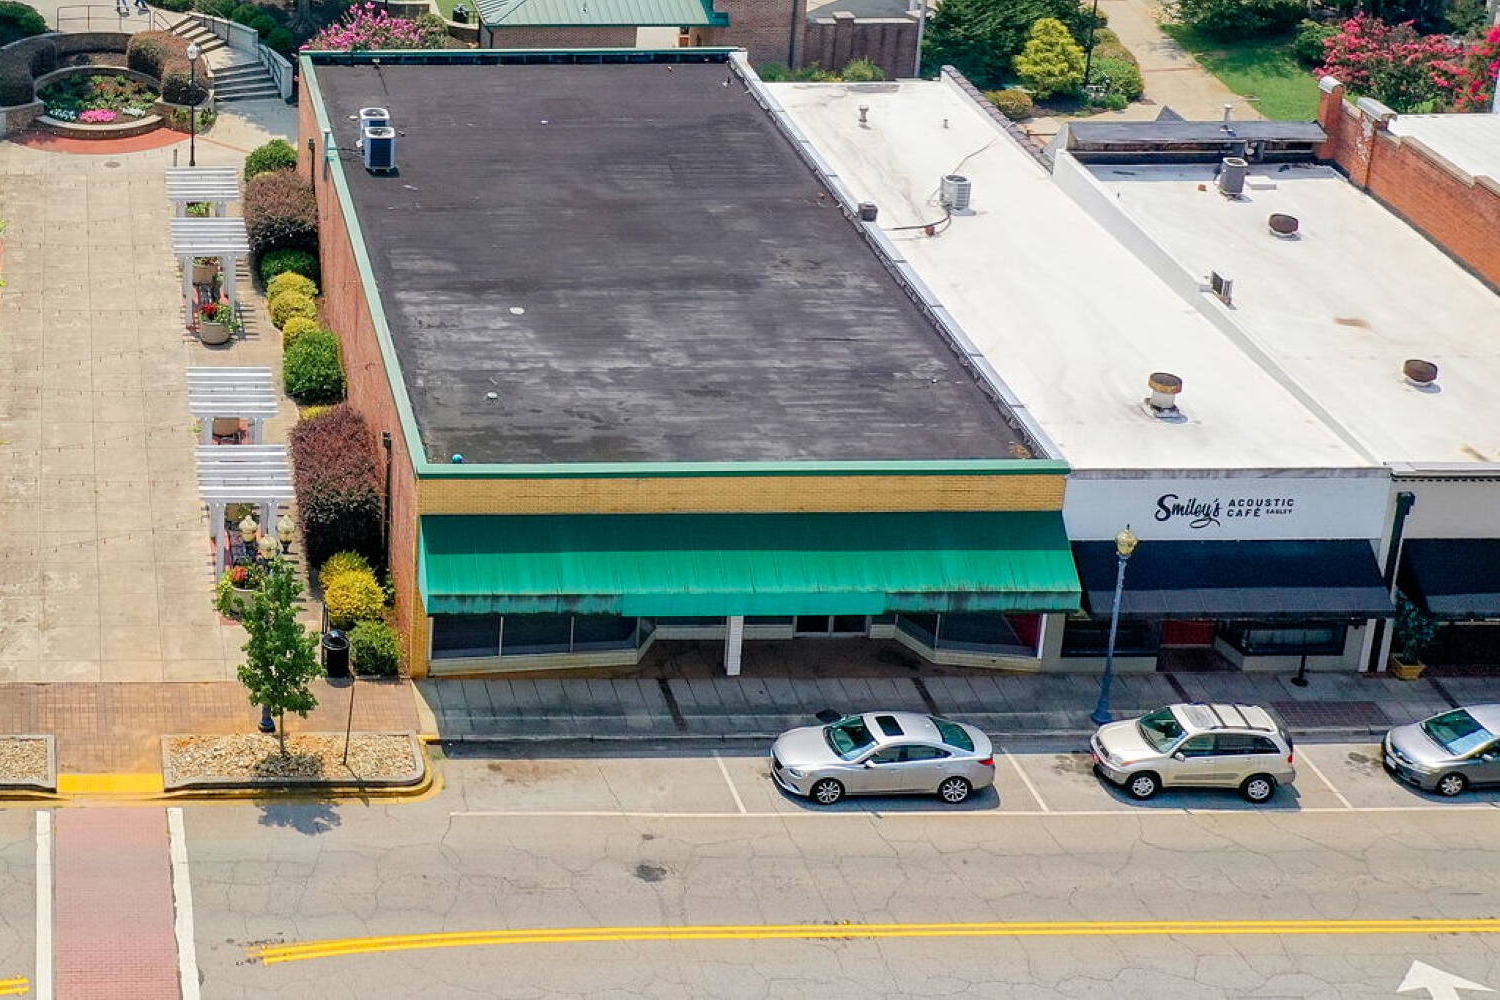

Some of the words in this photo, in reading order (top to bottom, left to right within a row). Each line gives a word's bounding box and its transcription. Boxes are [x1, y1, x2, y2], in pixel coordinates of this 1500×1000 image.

[1228, 498, 1295, 507] ACOUSTIC
[1154, 494, 1222, 528] Smiley's
[1227, 507, 1261, 517] CAFÉ
